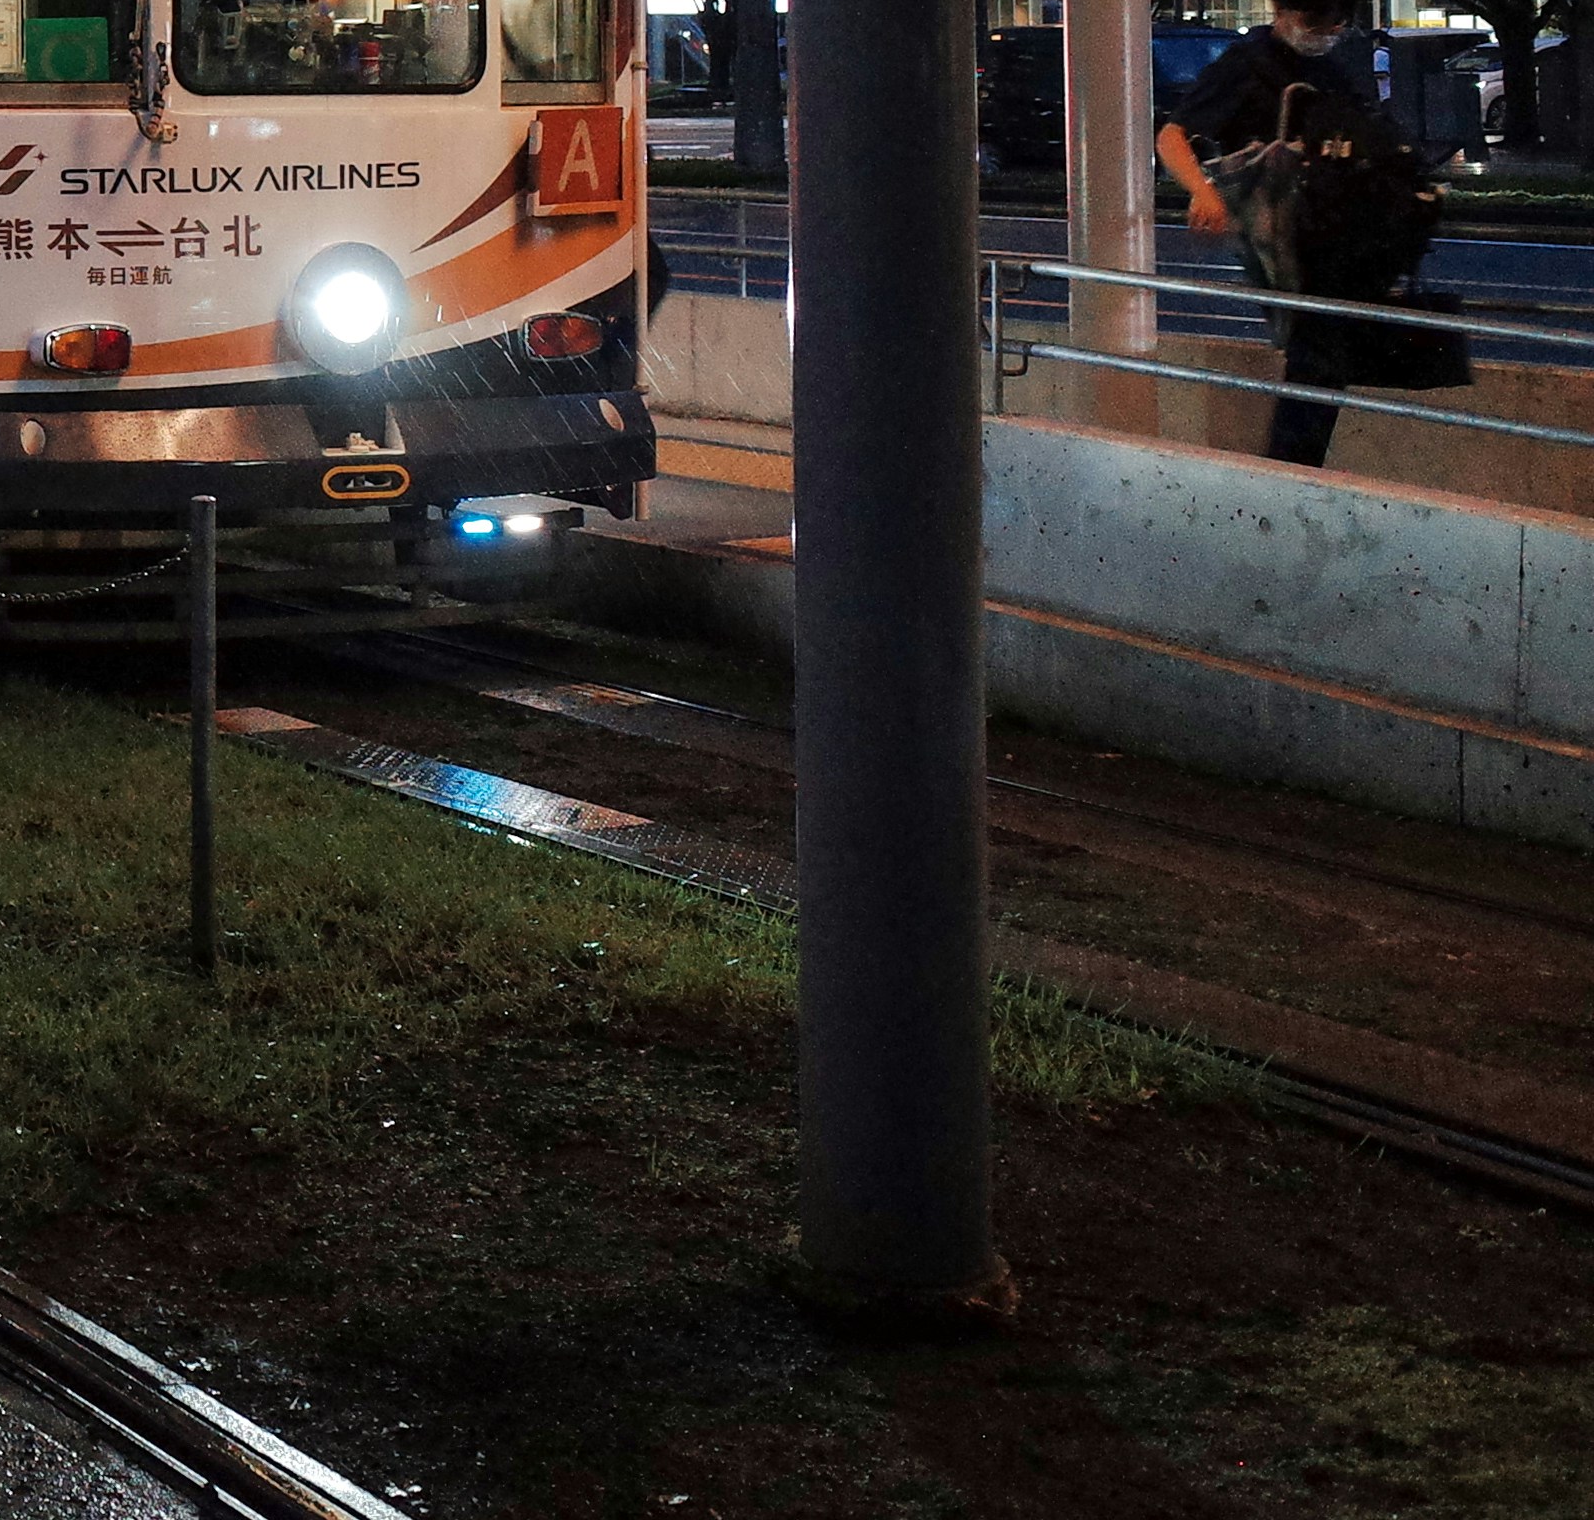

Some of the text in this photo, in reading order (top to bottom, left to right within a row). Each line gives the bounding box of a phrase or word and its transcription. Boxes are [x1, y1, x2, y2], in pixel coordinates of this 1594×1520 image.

[556, 120, 601, 193] A
[59, 161, 421, 194] STARLUX AIRLINES
[170, 215, 263, 258] 台北
[87, 265, 173, 286] 毎日運航
